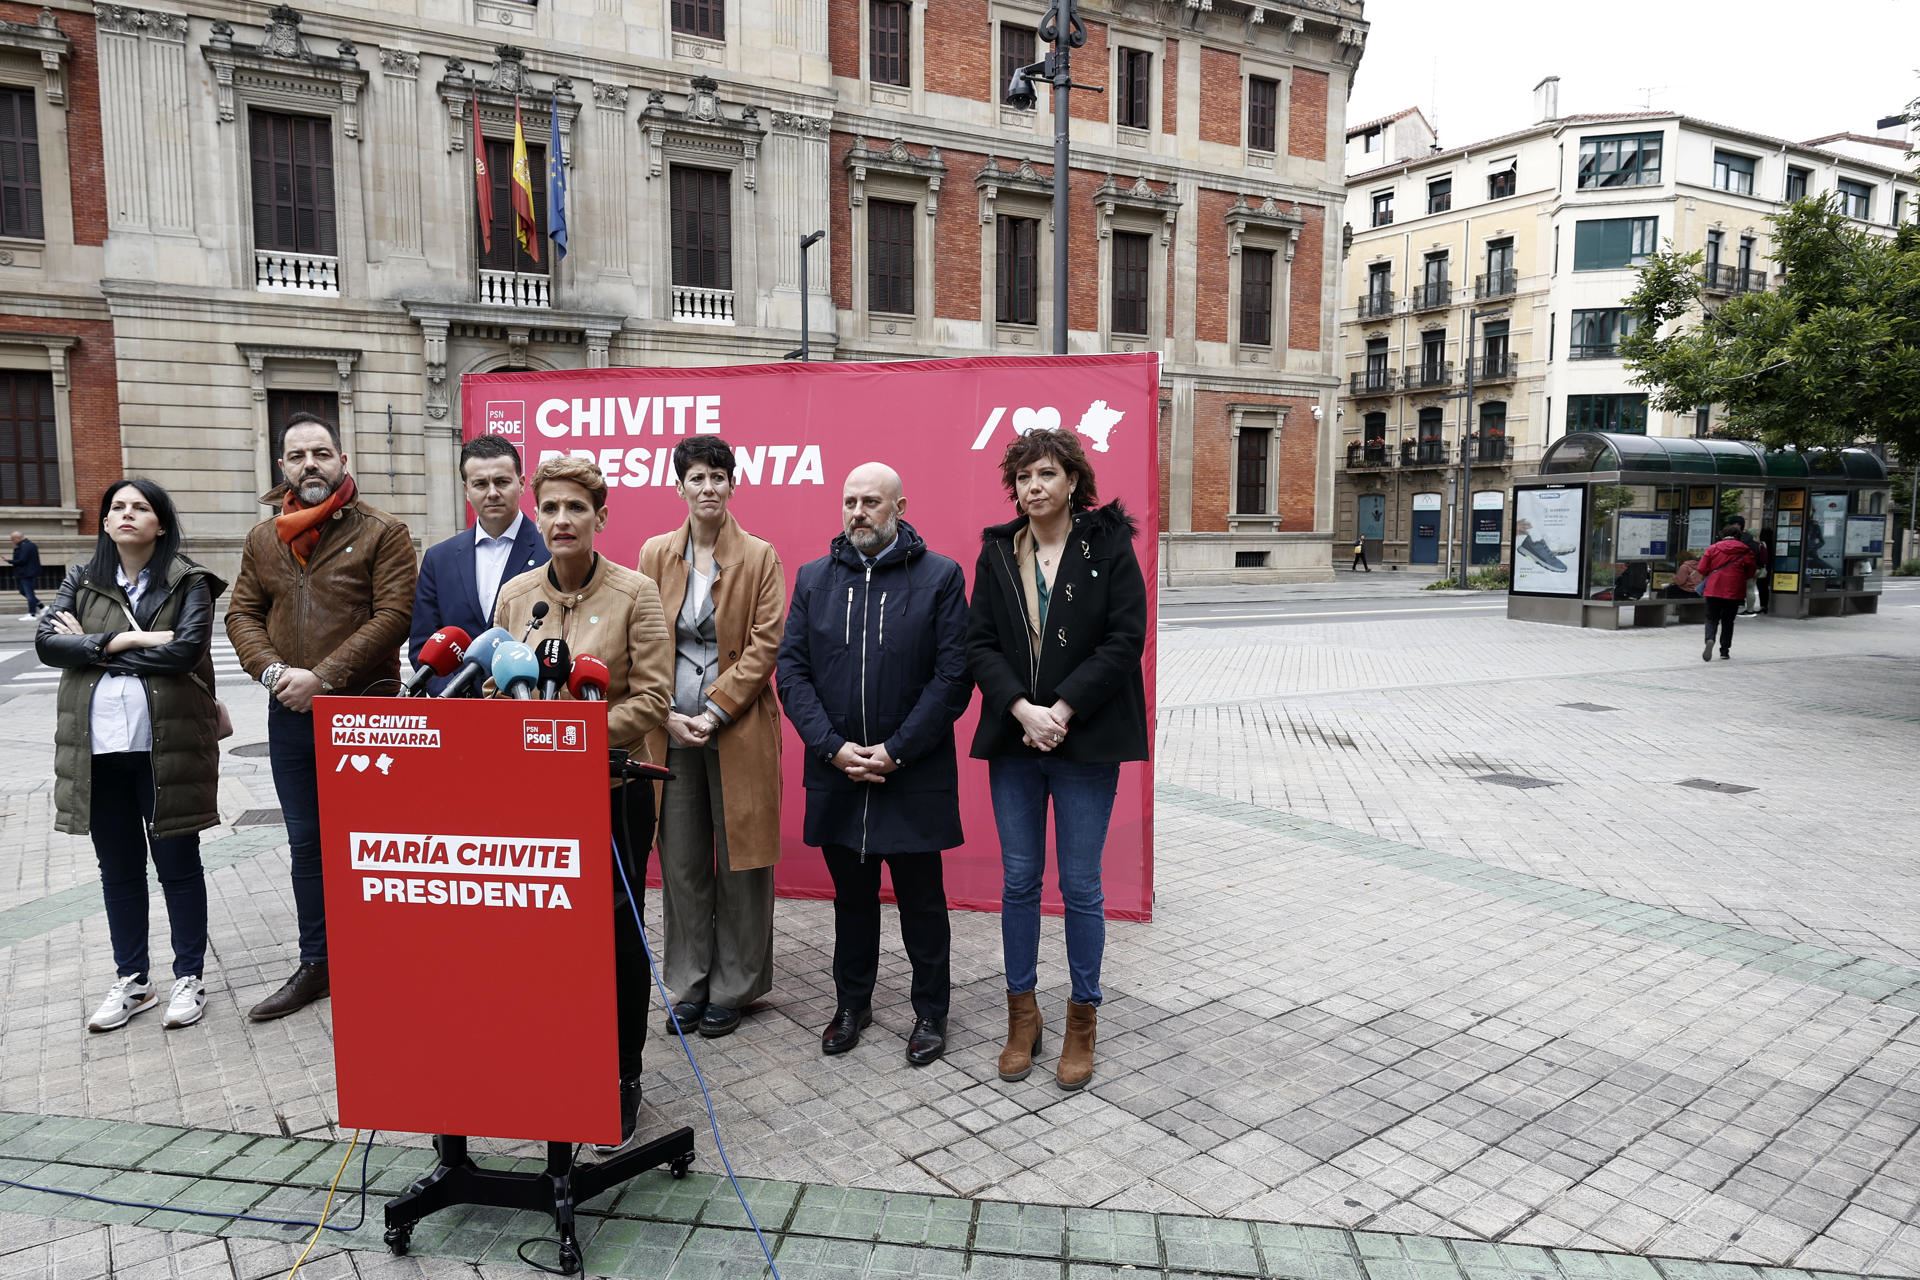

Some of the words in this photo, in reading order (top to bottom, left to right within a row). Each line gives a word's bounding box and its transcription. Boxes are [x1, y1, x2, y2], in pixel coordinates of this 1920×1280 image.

[489, 410, 504, 419] PSN
[536, 394, 721, 438] CHIVITE
[489, 420, 522, 435] PSOE
[538, 445, 825, 488] ESINTA
[332, 713, 367, 727] CON
[368, 714, 428, 729] CHIVITE
[333, 728, 366, 744] MÁS
[368, 731, 439, 746] NAVARRA
[526, 733, 553, 744] PSOE
[357, 835, 450, 865] MARÍA
[456, 842, 572, 869] CHIVITE
[362, 877, 573, 910] PRESIDENTA
